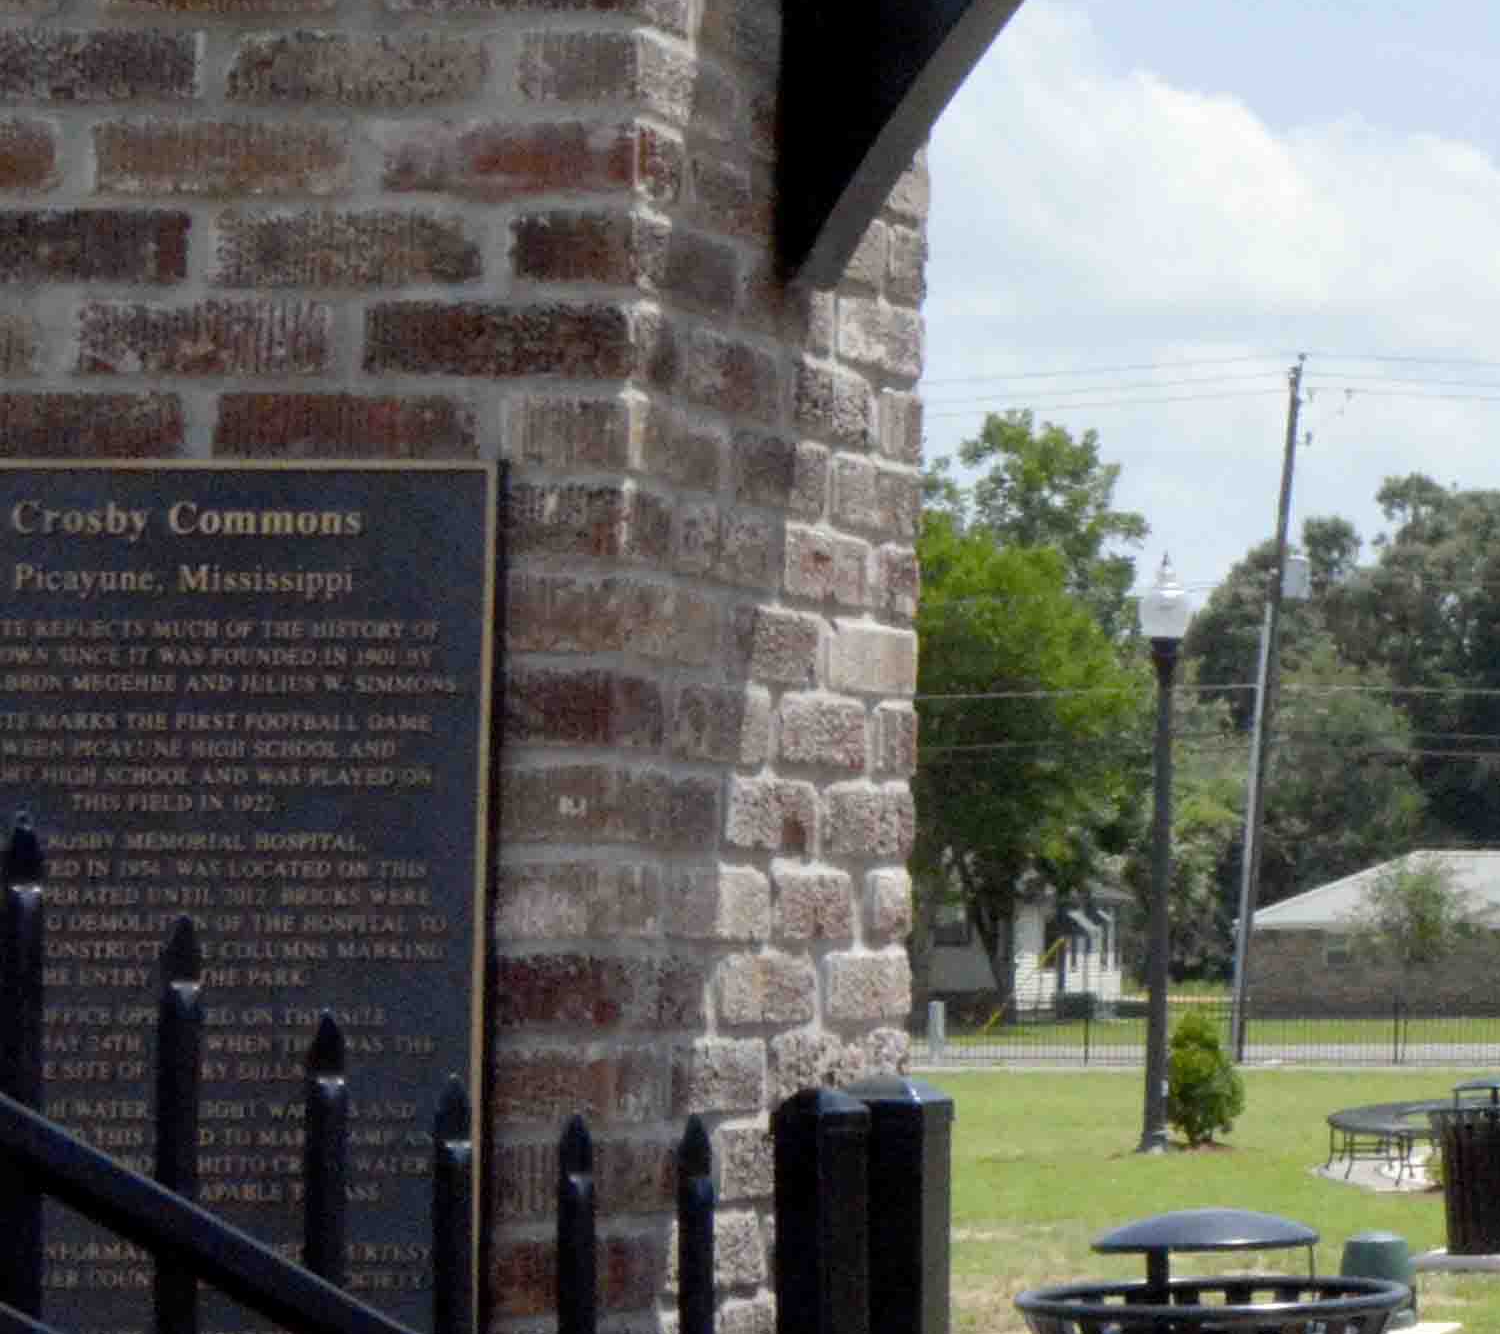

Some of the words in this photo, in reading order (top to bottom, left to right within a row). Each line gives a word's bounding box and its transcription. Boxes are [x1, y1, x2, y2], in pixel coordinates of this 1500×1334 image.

[11, 500, 148, 542] Crosby
[168, 500, 362, 535] Commons
[14, 563, 164, 599] Picayune,
[178, 563, 353, 599] Mississippi
[153, 620, 219, 639] MUCH
[226, 620, 253, 639] OF
[261, 620, 305, 639] THE
[312, 620, 405, 639] HISTORY
[158, 647, 206, 666] WAS
[210, 647, 317, 666] FOUNDED
[185, 674, 234, 692] AND
[355, 674, 457, 694] SIMMONS
[38, 712, 118, 731] MARKS
[126, 712, 168, 731] THE
[175, 712, 238, 731] FIRST
[245, 712, 361, 732] FOOTBALL
[367, 712, 434, 733] GAME
[72, 739, 183, 758] PICAYUNE
[191, 739, 246, 758] HIGH
[252, 739, 341, 759] SCHOOL
[348, 739, 397, 759] AND
[104, 767, 188, 786] SCHOOL
[199, 767, 249, 786] AND
[308, 767, 394, 786] PLAYED
[127, 793, 193, 812] FIELD
[123, 832, 247, 852] MEMORIAL
[228, 860, 332, 879] LOCATED
[377, 860, 429, 878] THIS
[252, 914, 297, 933] THE
[303, 914, 410, 934] HOSPITAL
[46, 940, 165, 960] ONSTRUCT
[219, 941, 330, 961] COLUMNS
